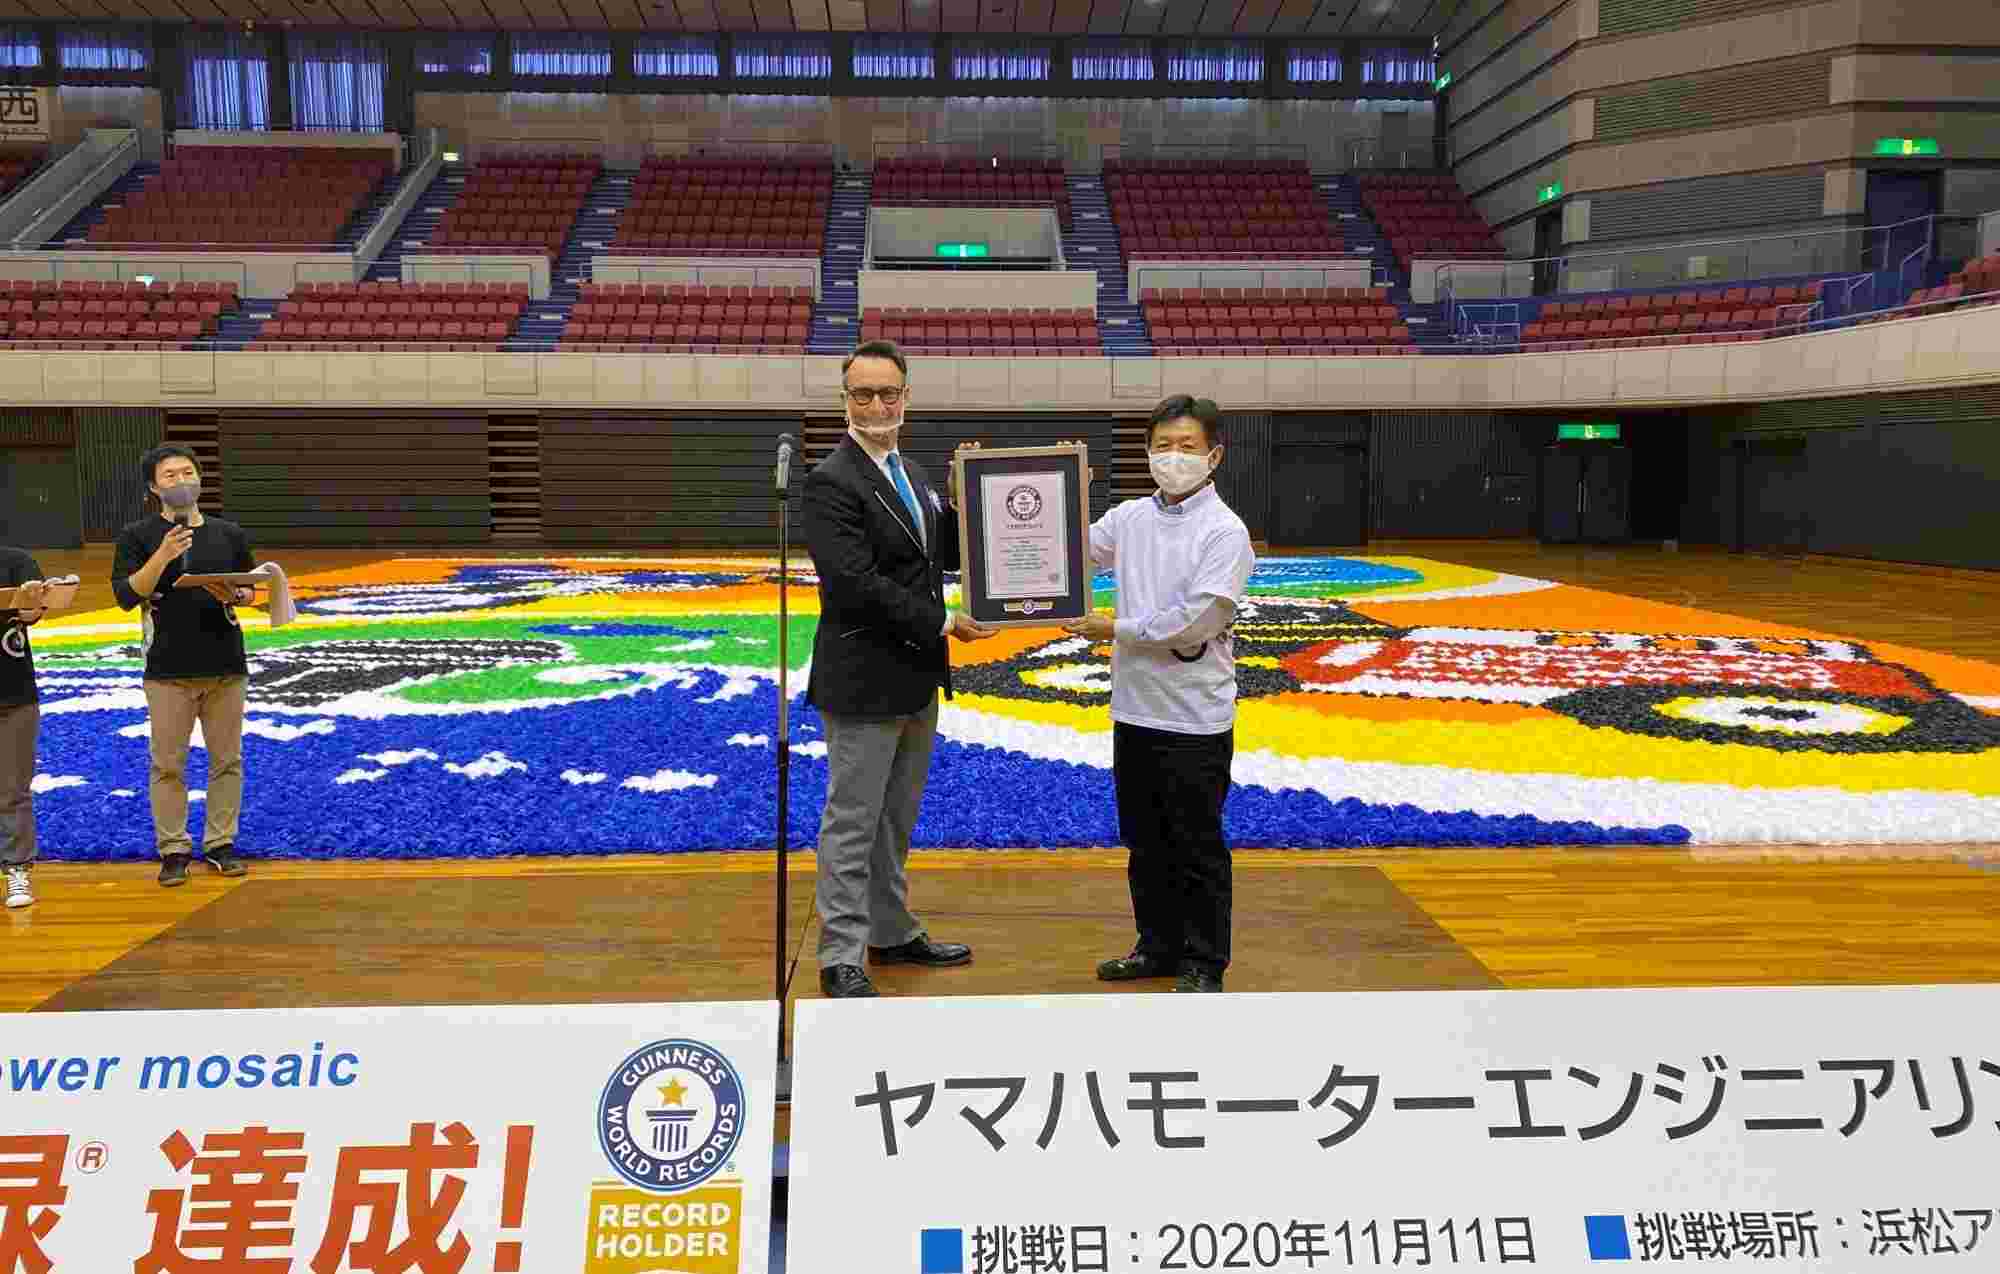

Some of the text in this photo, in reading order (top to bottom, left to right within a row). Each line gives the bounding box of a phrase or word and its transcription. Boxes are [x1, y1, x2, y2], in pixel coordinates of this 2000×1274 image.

[0, 1041, 359, 1091] wer mosaic
[622, 1048, 726, 1086] GUINNESS
[854, 1054, 2000, 1156] ヤマハモーターエンジニアリ
[607, 1103, 737, 1182] WORLD RECORDS
[134, 1122, 535, 1274] 達成!
[599, 1202, 731, 1228] RECORD
[596, 1231, 728, 1257] HOLDER
[1634, 1207, 2000, 1262] 挑戦場所：浜松ア
